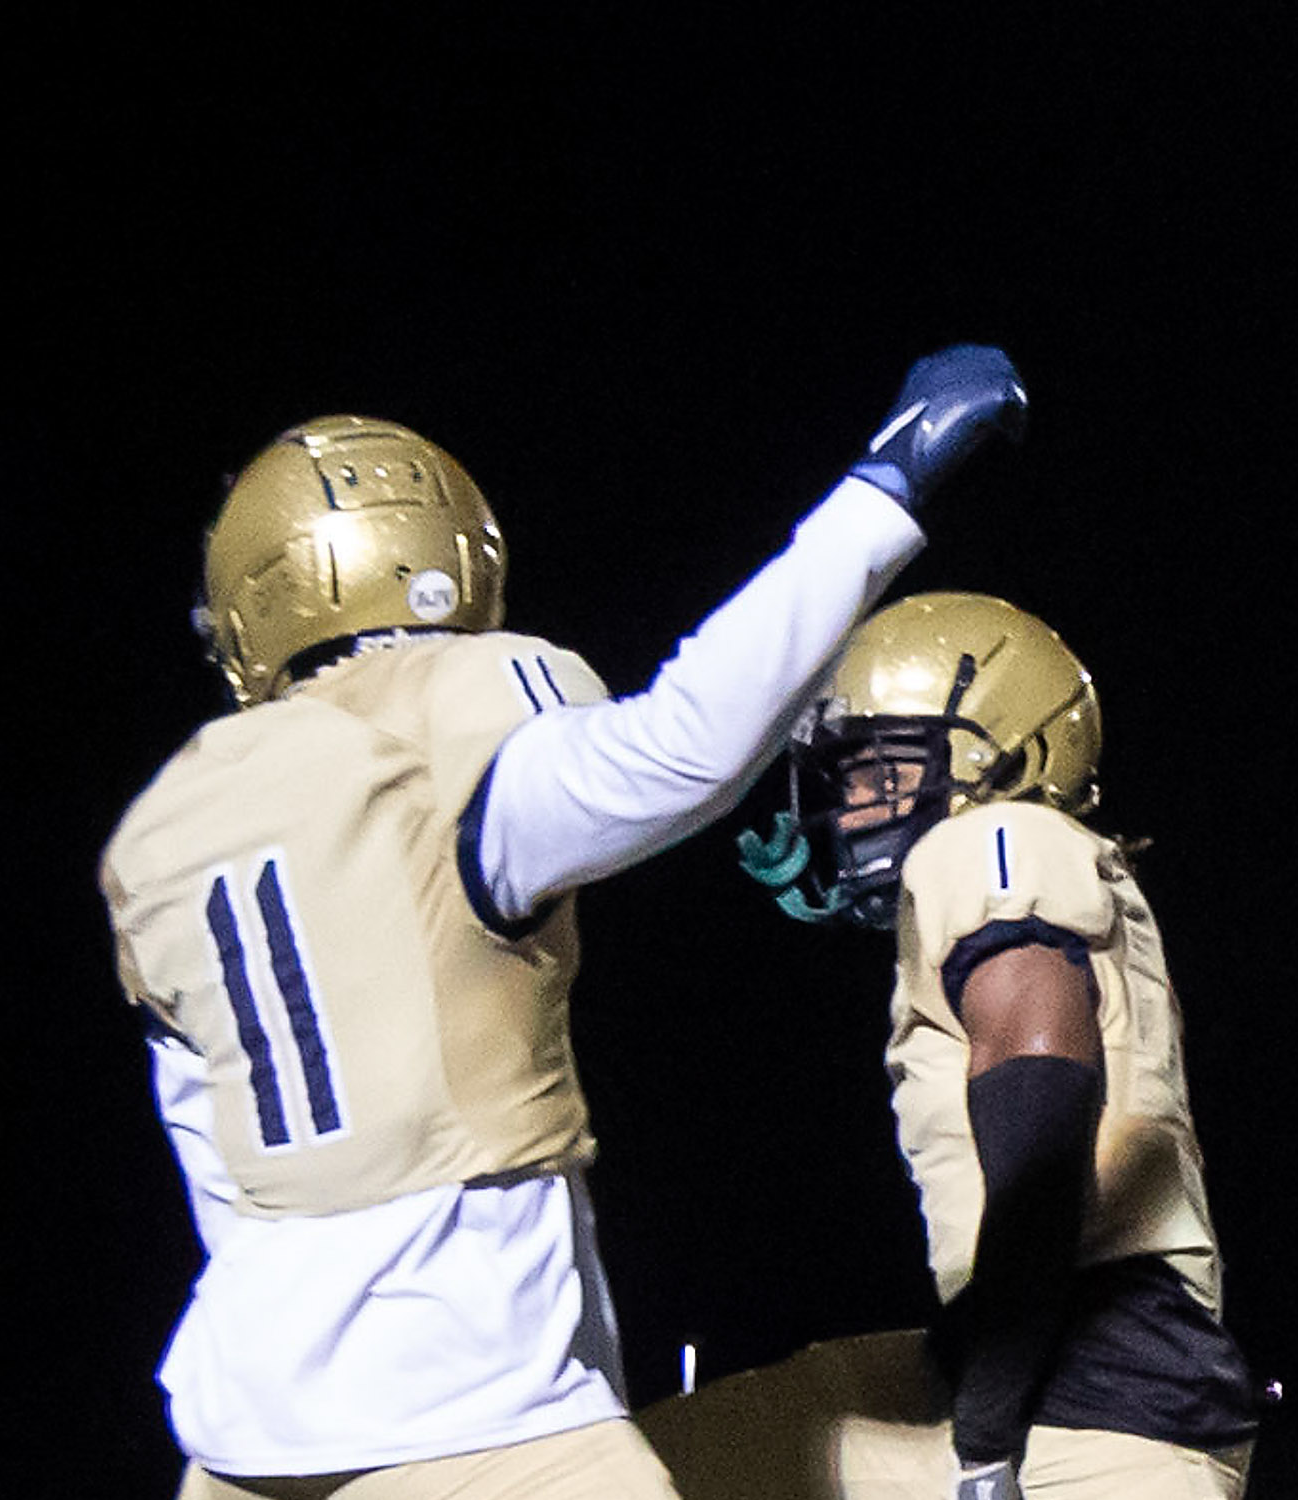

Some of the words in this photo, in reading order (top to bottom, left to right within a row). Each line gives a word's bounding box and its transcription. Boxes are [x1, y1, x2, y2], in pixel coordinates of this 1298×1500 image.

[510, 655, 566, 715] 11
[996, 826, 1009, 889] 1
[205, 858, 343, 1148] 11
